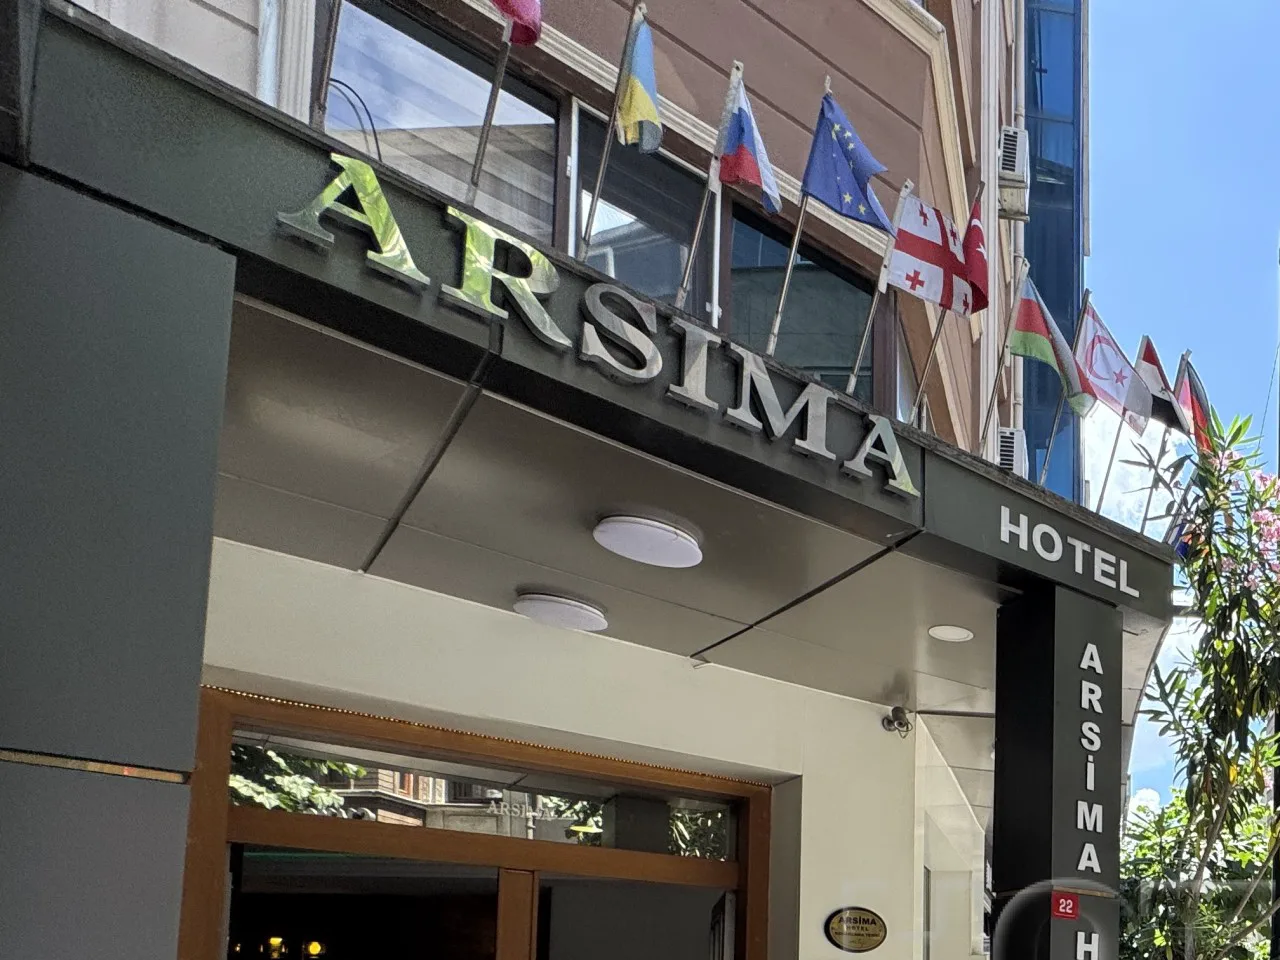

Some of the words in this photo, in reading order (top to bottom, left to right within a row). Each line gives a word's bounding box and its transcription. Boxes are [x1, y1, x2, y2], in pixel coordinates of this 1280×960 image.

[276, 152, 921, 498] ARSIMA
[1001, 505, 1140, 598] HOTEL
[1059, 898, 1073, 914] 22
